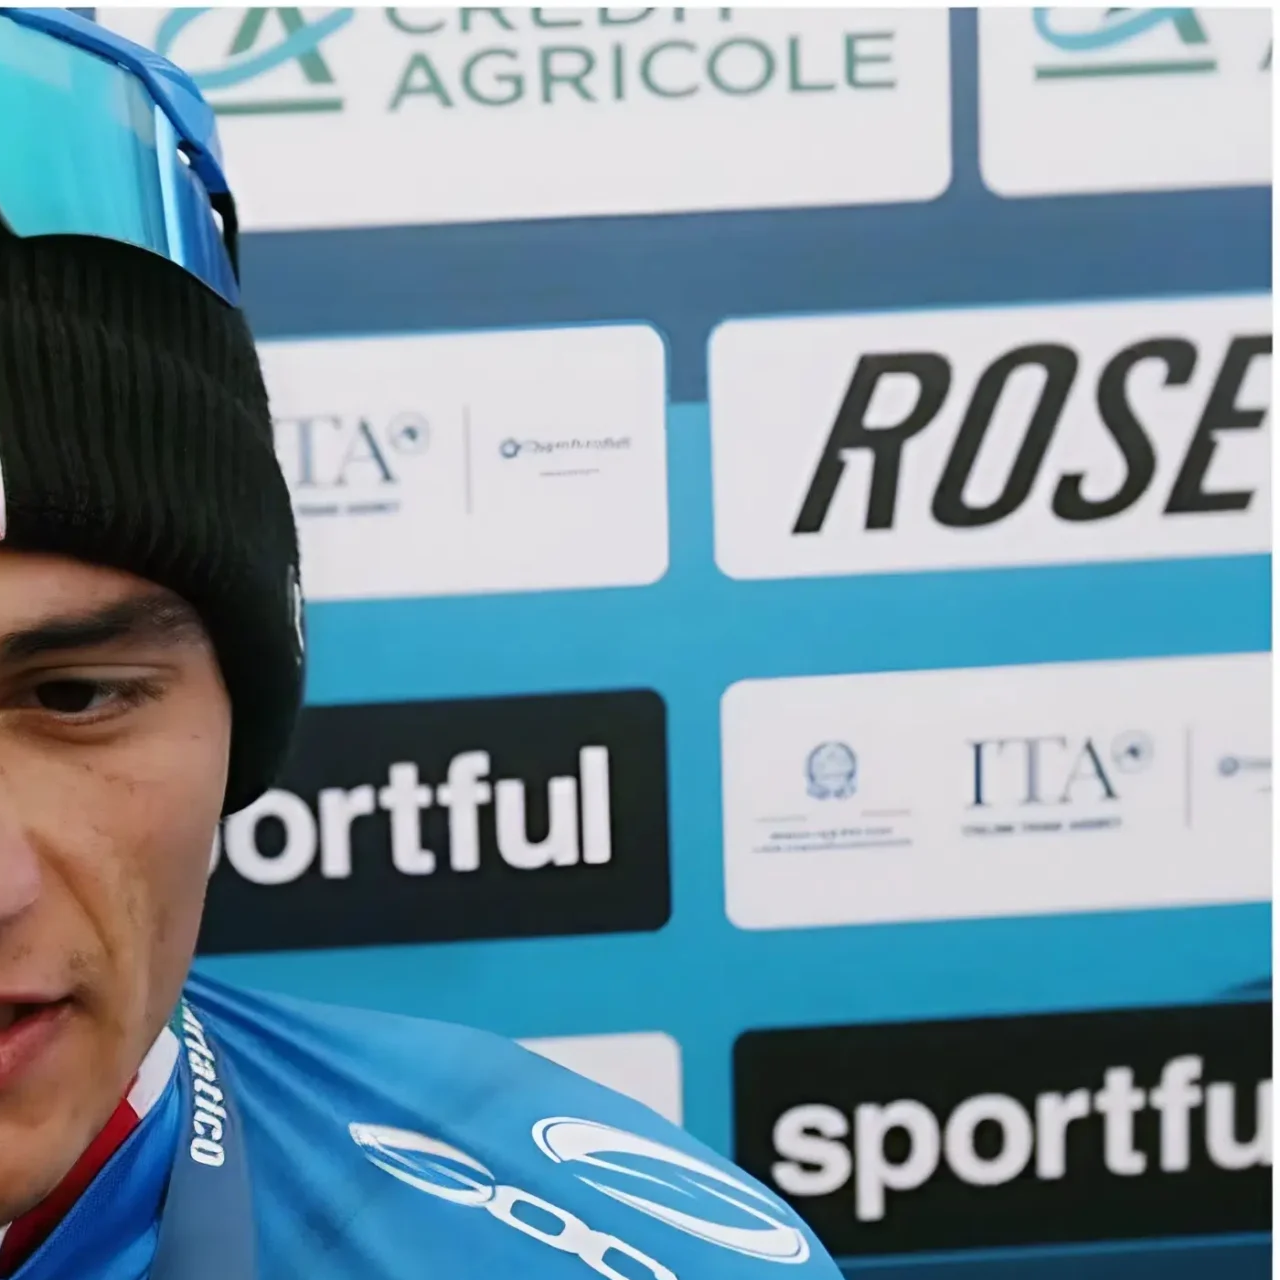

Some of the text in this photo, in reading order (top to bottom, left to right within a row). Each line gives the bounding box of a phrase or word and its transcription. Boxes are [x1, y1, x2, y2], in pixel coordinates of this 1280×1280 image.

[386, 30, 898, 113] AGRICOLE
[792, 334, 1272, 536] ROSE
[209, 745, 613, 885] ortful
[965, 735, 1121, 808] ITA
[771, 1055, 1272, 1222] sportfu
